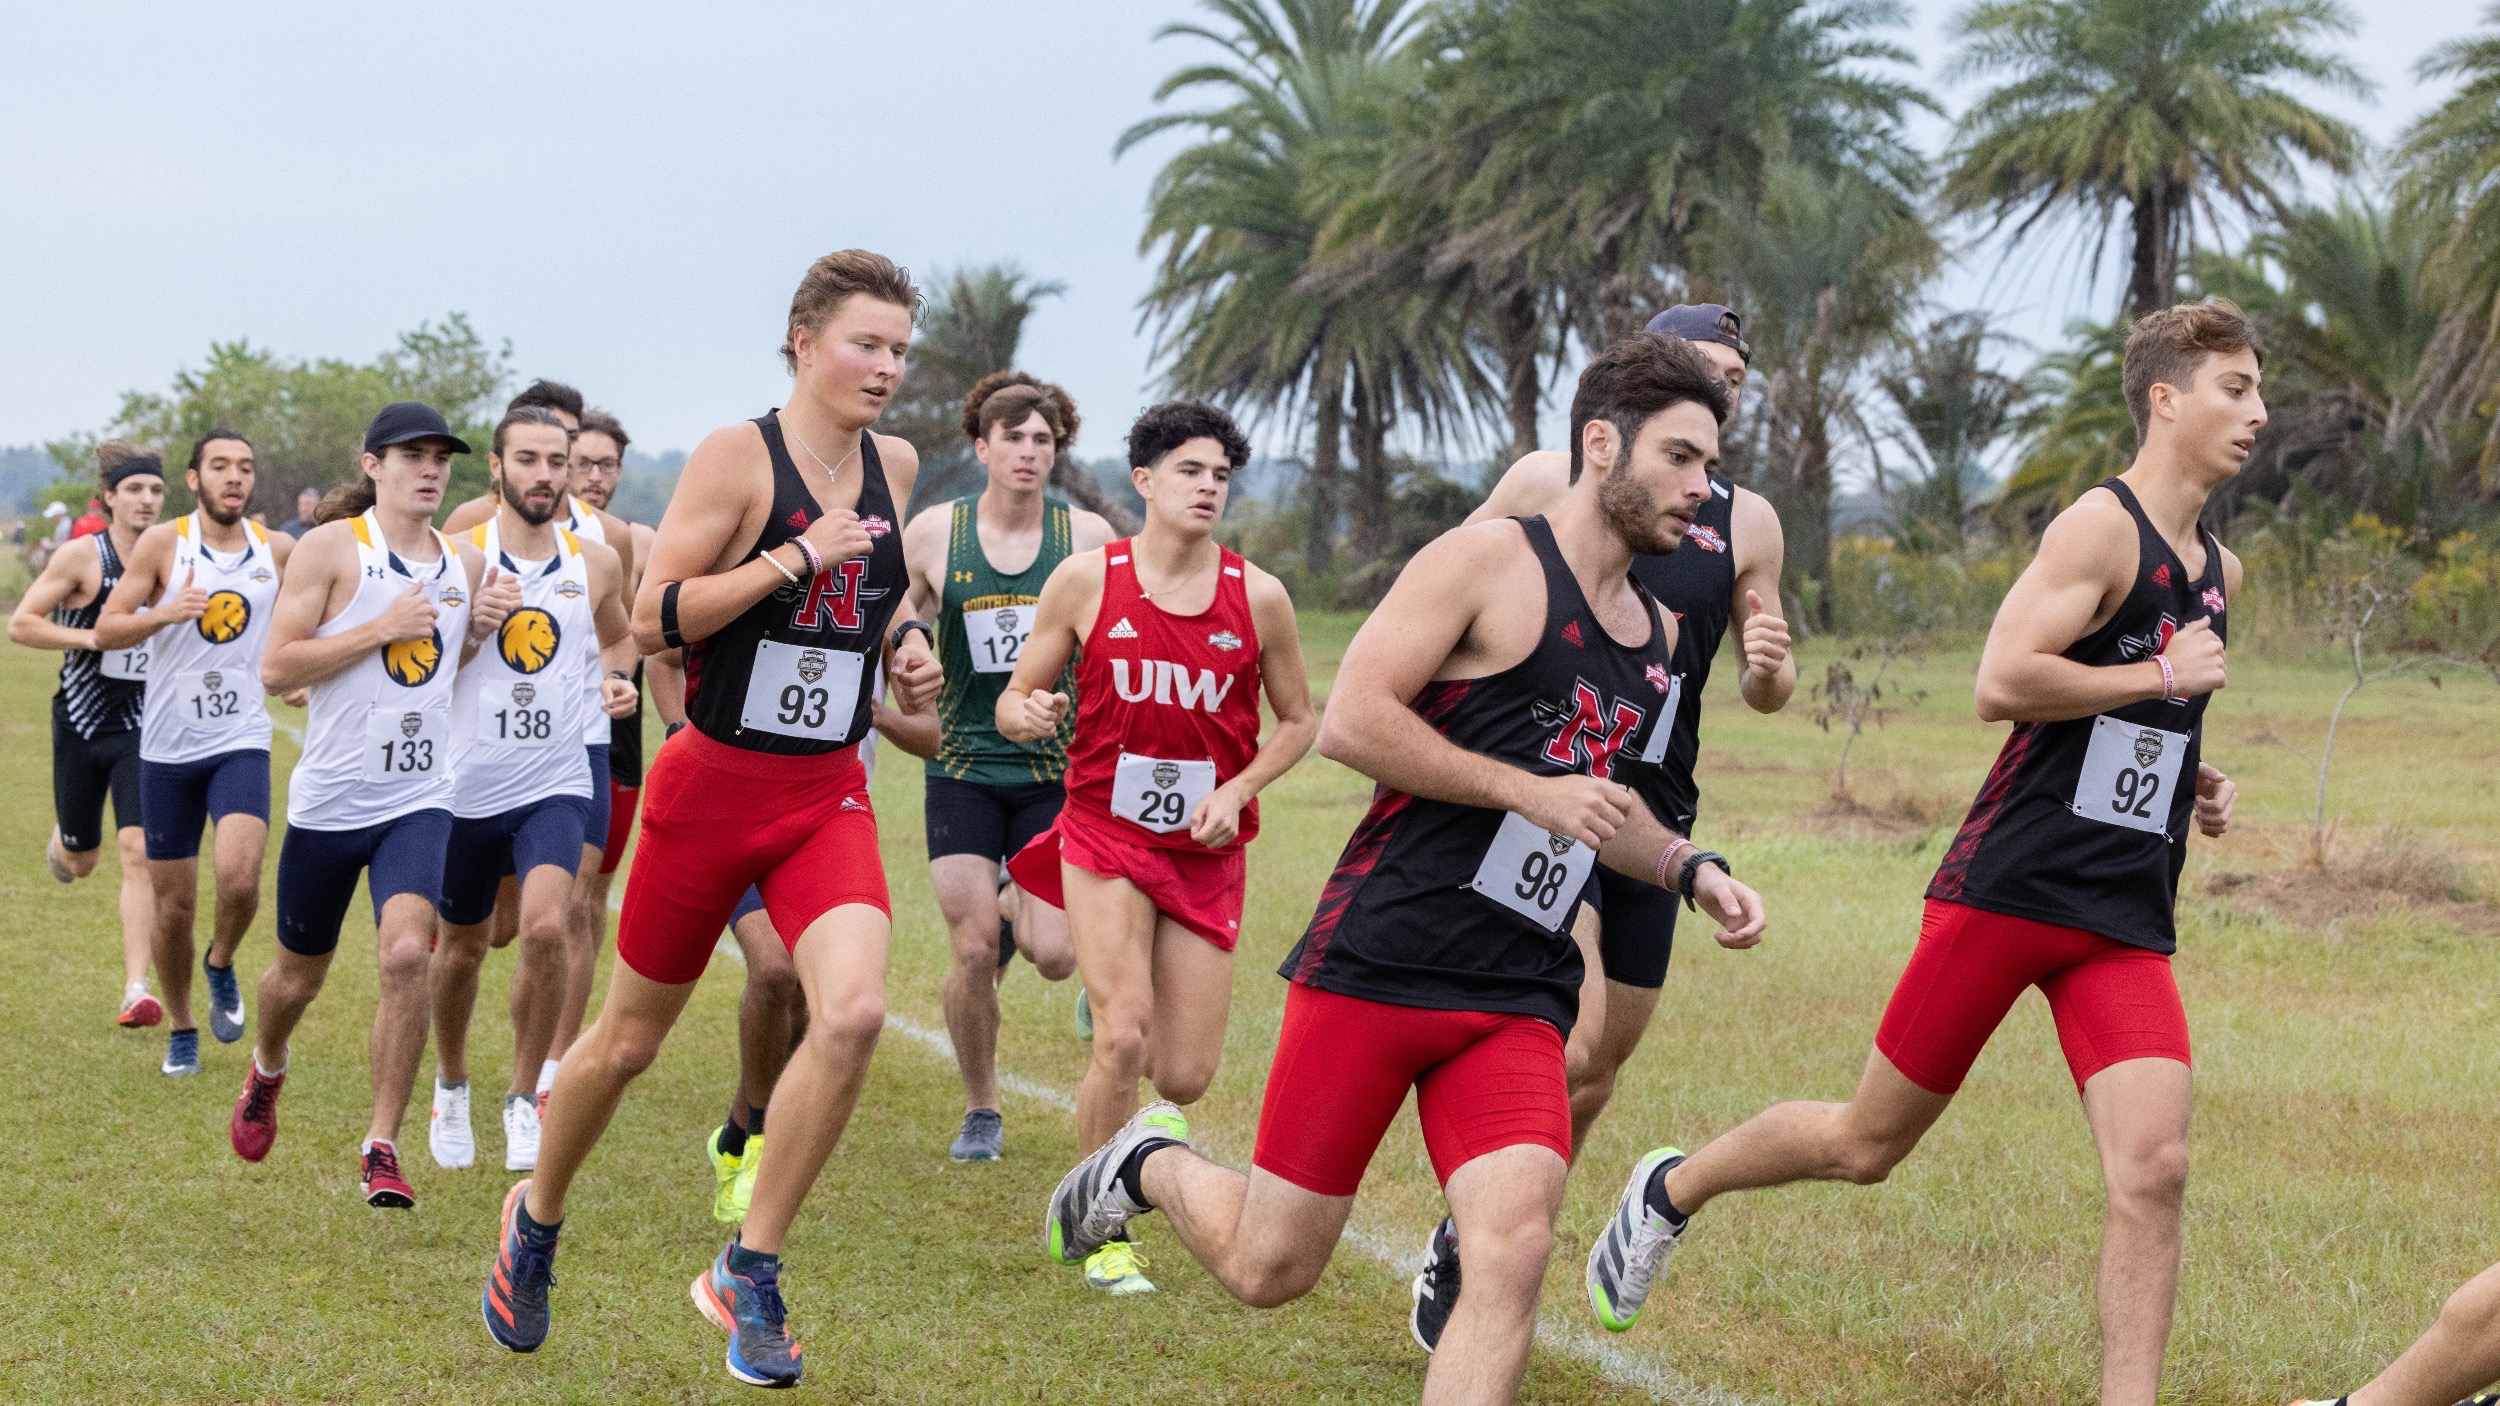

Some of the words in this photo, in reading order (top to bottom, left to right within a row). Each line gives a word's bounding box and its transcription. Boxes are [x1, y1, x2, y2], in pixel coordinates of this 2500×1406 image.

[787, 519, 809, 529] adida
[1688, 524, 1726, 552] SOUTHLAND
[2202, 591, 2224, 611] SOUTHLAN
[1108, 630, 1138, 638] adidas
[122, 651, 149, 674] 12
[1109, 658, 1235, 713] UIW
[191, 690, 240, 719] 132
[777, 684, 829, 729] 93
[495, 709, 551, 739] 138
[381, 740, 433, 773] 133
[1138, 790, 1185, 826] 29
[2111, 768, 2160, 819] 92
[1514, 851, 1568, 912] 98
